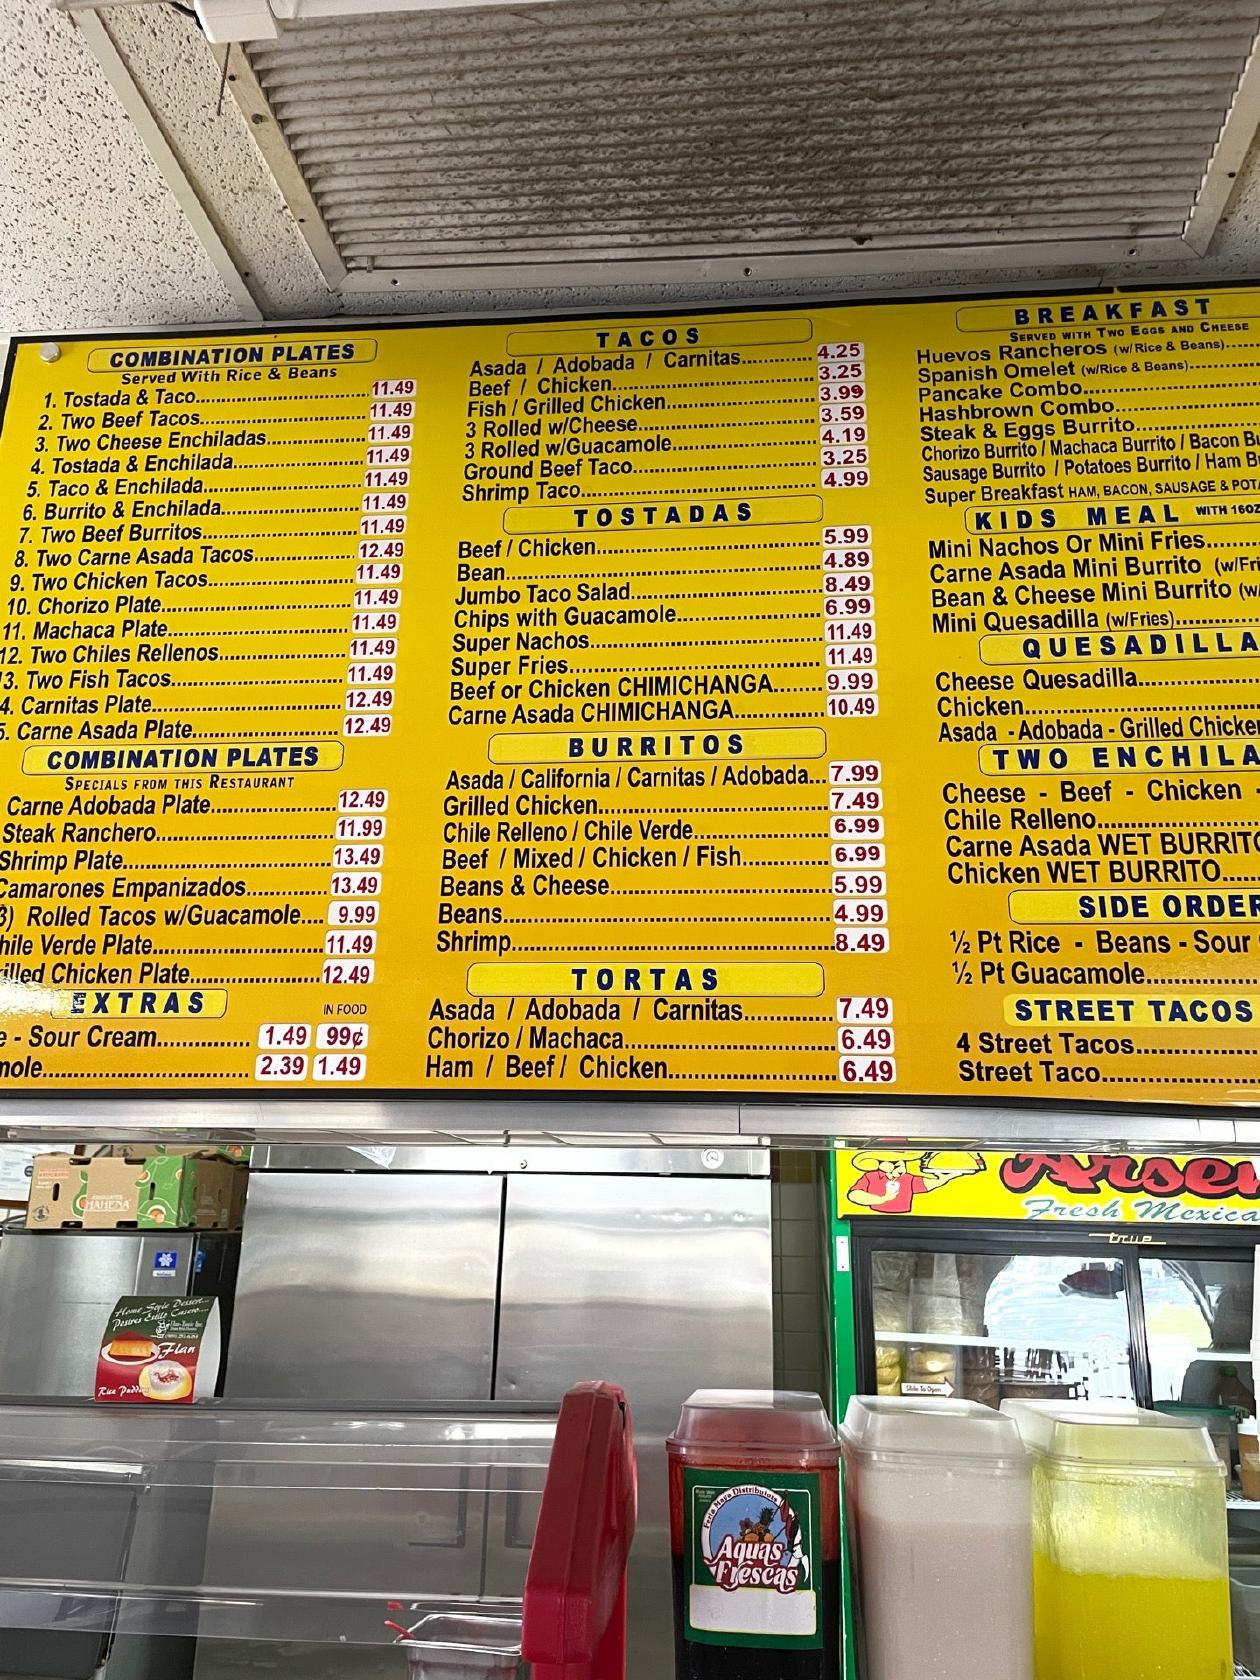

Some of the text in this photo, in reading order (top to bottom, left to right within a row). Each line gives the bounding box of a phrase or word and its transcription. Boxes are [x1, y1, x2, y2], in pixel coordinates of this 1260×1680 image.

[1014, 298, 1211, 326] BREAKFAST
[596, 328, 700, 348] TACOS
[110, 344, 354, 368] COMBINATION PLATES
[470, 360, 526, 377] Asada
[537, 358, 543, 374] /
[553, 355, 635, 374] Adobada
[646, 353, 652, 369] /
[817, 344, 860, 359] 4.25
[122, 367, 336, 385] Served With Rice & Beans
[918, 369, 998, 386] Spanish
[1004, 361, 1075, 378] Omelet
[1131, 362, 1140, 372] &
[45, 393, 56, 408] 1.
[64, 390, 130, 407] Tostada
[136, 389, 148, 405] &
[373, 381, 413, 395] 11.49
[920, 404, 1033, 422] Hashbrown
[35, 437, 48, 452] 3.
[57, 436, 90, 451] Two
[97, 434, 162, 450] Cheese
[369, 425, 410, 440] 11.49
[465, 442, 474, 459] 3
[482, 439, 539, 458] Rolled
[822, 427, 865, 443] 4.19
[463, 484, 529, 504] Shrimp
[824, 471, 868, 487] 4.99
[925, 488, 976, 507] Super
[981, 483, 1064, 501] Breakfast
[1069, 486, 1099, 498] HAM,
[1103, 484, 1151, 496] BACON,
[1155, 480, 1216, 494] SAUSAGE
[1221, 480, 1229, 491] &
[574, 503, 752, 527] TOSTADAS
[976, 509, 1055, 530] KIDS
[1087, 503, 1179, 526] MEAL
[1196, 506, 1227, 515] WITH
[15, 550, 28, 567] 8.
[37, 550, 71, 566] Two
[78, 549, 130, 565] Carne
[136, 547, 193, 564] Asada
[360, 543, 403, 557] 12.49
[455, 586, 520, 605] Jumbo
[527, 585, 571, 603] Taco
[826, 576, 870, 592] 8.49
[8, 598, 30, 615] 10.
[39, 597, 109, 614] Chorizo
[355, 590, 398, 605] 11.49
[31, 646, 66, 663] Two
[73, 645, 130, 663] Chiles
[351, 640, 394, 655] 11.49
[451, 681, 496, 700] Beef
[502, 685, 522, 699] or
[529, 679, 609, 698] Chicken
[828, 673, 873, 690] 9.99
[936, 672, 1013, 691] Cheese
[569, 734, 742, 757] BURRITOS
[48, 747, 318, 769] COMBINATION PLATES
[993, 748, 1067, 770] TWO
[8, 796, 63, 816] Carne
[68, 795, 155, 815] Adobada
[340, 791, 384, 807] 12.49
[444, 795, 508, 816] Grilled
[832, 792, 879, 809] 7.49
[945, 809, 1001, 830] Chile
[441, 876, 503, 896] Beans
[511, 875, 525, 896] &
[835, 876, 882, 893] 5.99
[1079, 896, 1149, 918] SIDE
[836, 934, 884, 951] 8.49
[572, 969, 717, 990] TORTAS
[981, 962, 1005, 984] Pt
[71, 992, 203, 1013] EXTRAS
[323, 1003, 367, 1015] IN FOOD
[1016, 998, 1253, 1021] STREET TACOS
[29, 1025, 80, 1047] Sour
[266, 1026, 306, 1045] 1.49
[327, 1027, 363, 1049] 99¢
[429, 1026, 509, 1049] Chorizo
[516, 1026, 523, 1049] /
[842, 1029, 890, 1049] 6.49
[957, 1033, 970, 1052] 4
[979, 1032, 1052, 1053] Street
[1024, 1199, 1120, 1221] Fresh
[1099, 1232, 1159, 1245] true
[115, 1307, 142, 1317] Home
[158, 1342, 195, 1359] Flan
[98, 1386, 116, 1397] Rice
[717, 1560, 798, 1592] Frescas
